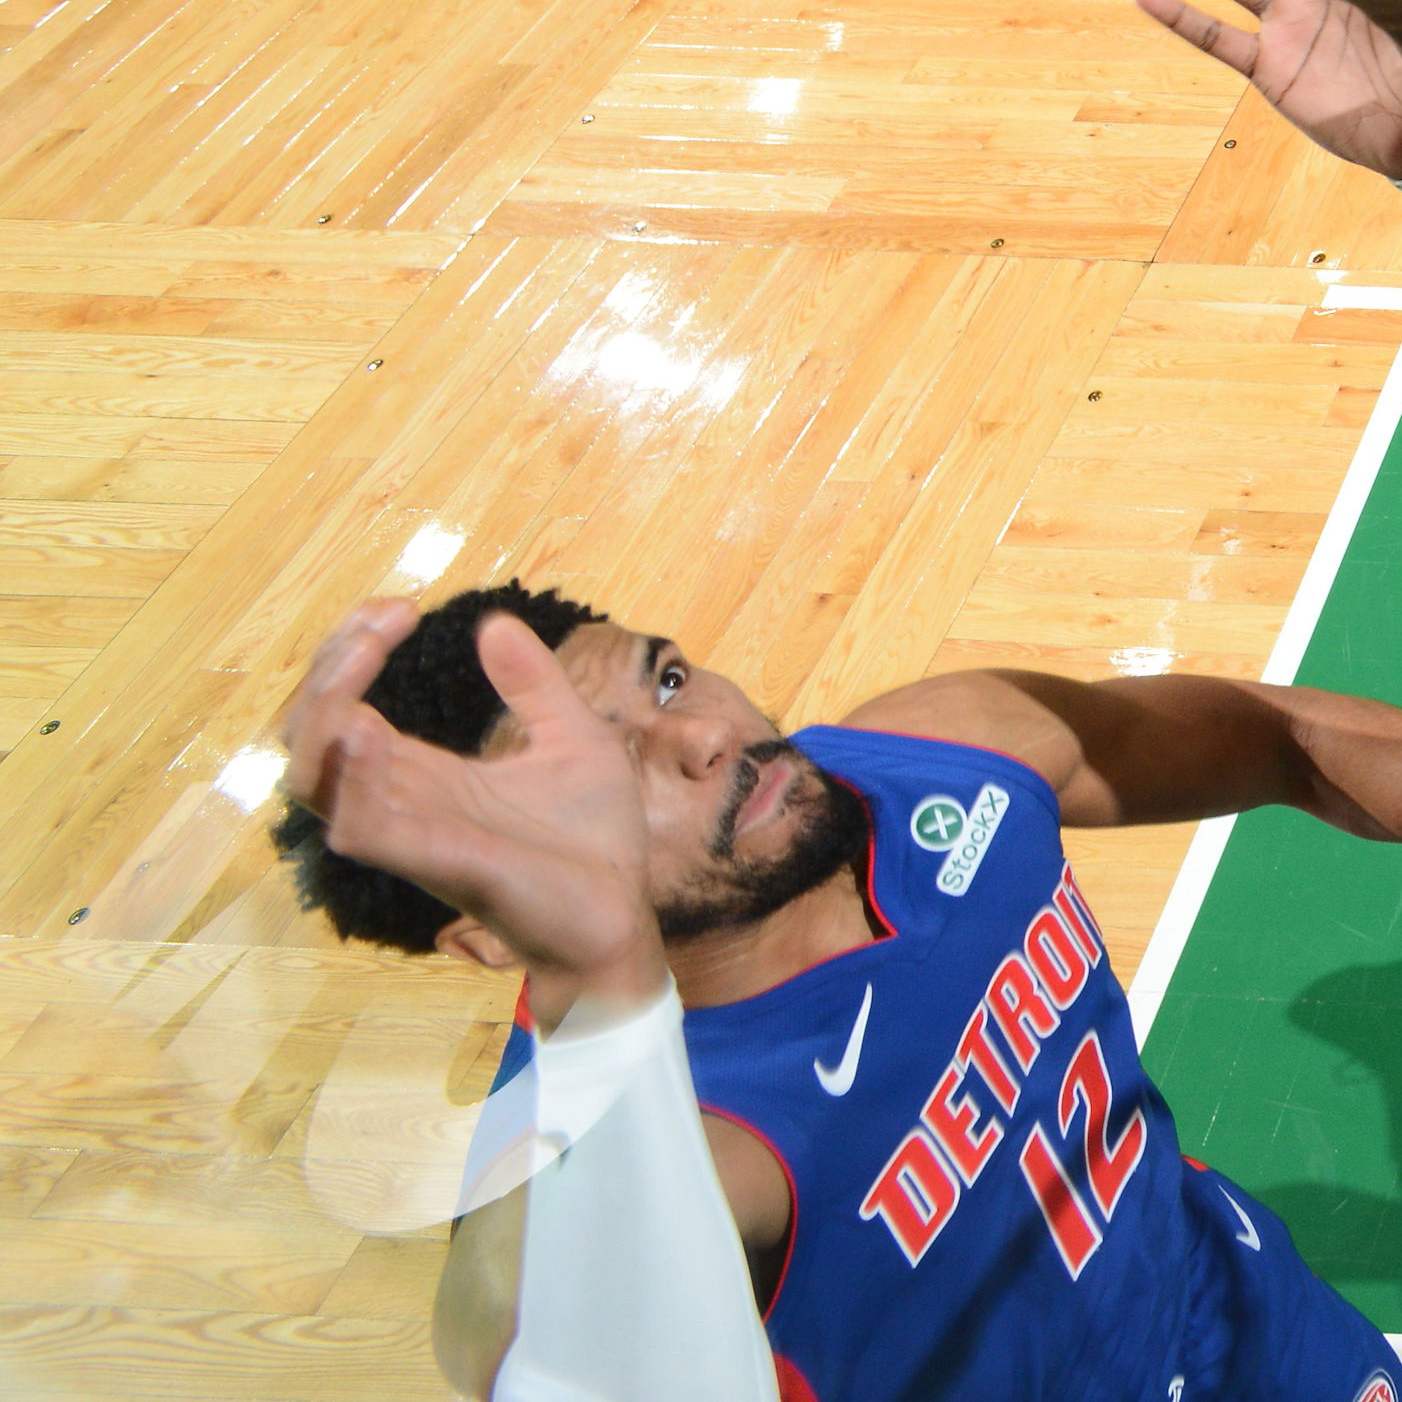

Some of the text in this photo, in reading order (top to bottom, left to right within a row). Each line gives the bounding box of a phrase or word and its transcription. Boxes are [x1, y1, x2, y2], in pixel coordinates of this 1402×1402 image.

[942, 790, 1005, 890] StockX
[858, 860, 1104, 1268] DETROIT
[1018, 1029, 1147, 1281] 12
